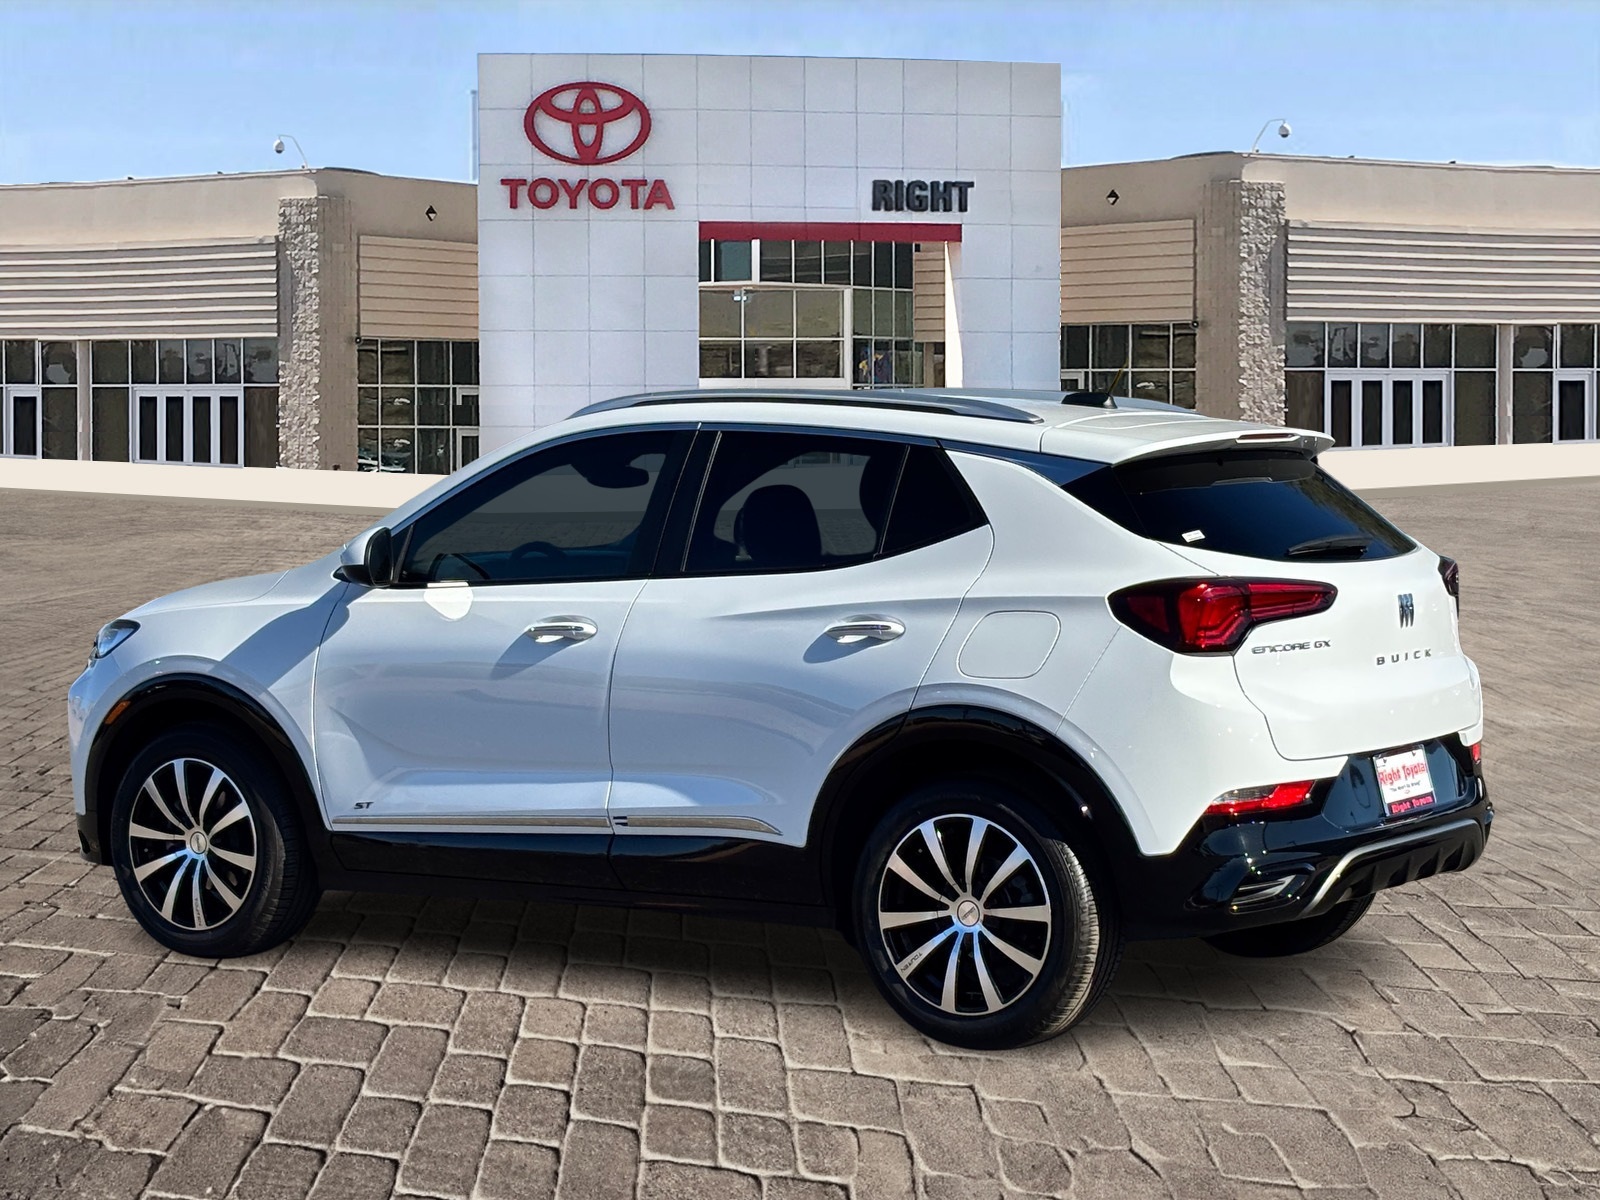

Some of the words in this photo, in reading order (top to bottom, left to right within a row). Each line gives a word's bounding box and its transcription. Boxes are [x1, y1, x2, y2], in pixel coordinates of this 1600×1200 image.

[501, 178, 675, 210] TOYOTA
[872, 179, 975, 212] RIGHT
[1252, 642, 1311, 654] ENCORE
[1314, 640, 1331, 649] GX
[1376, 649, 1431, 665] BUICK
[1378, 768, 1401, 786] Right
[1402, 761, 1428, 781] Toyota
[354, 801, 375, 810] ST
